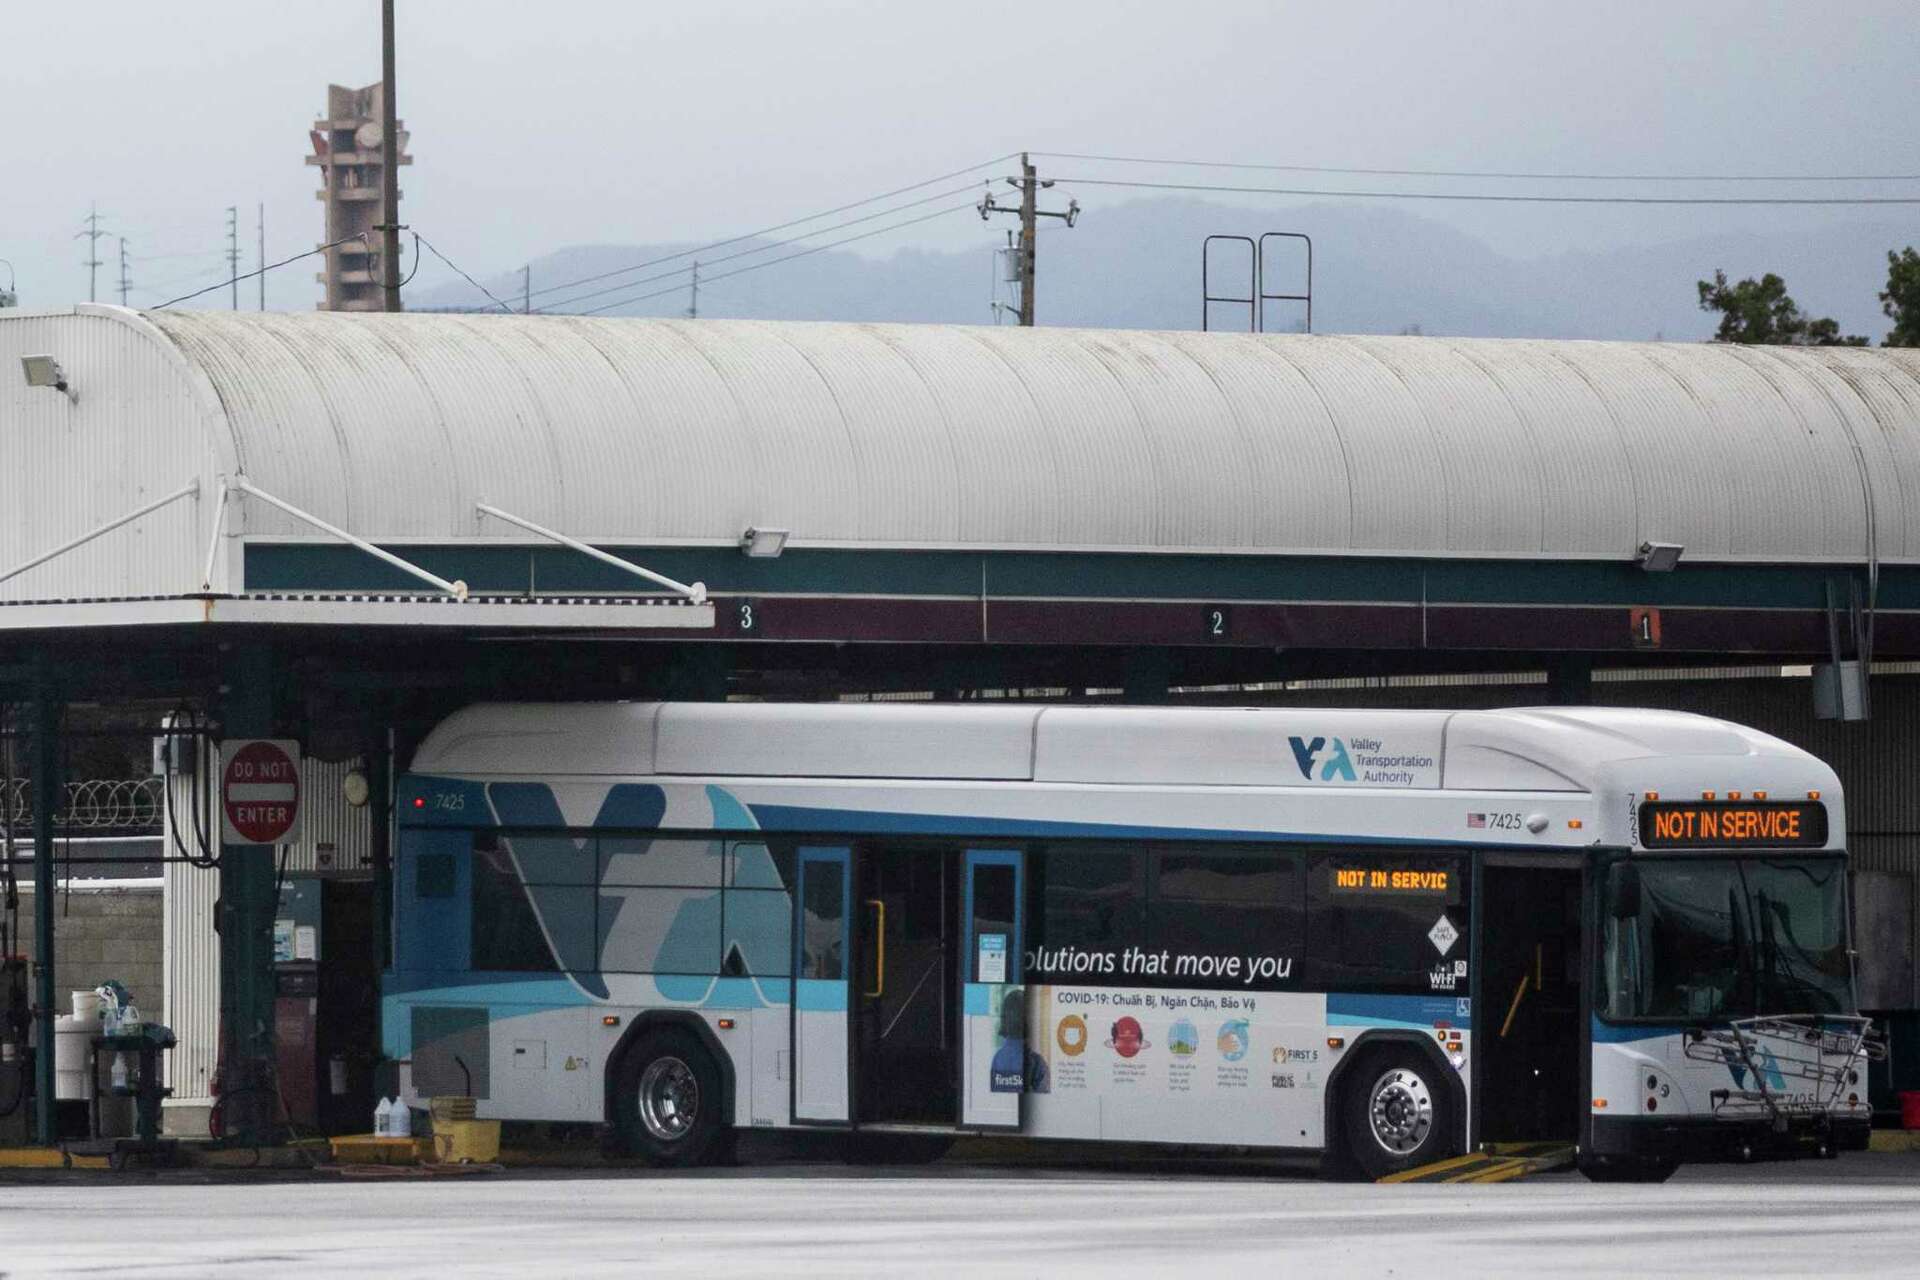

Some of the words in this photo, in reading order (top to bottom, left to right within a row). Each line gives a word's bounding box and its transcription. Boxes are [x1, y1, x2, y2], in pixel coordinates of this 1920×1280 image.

[741, 605, 752, 629] 3
[1212, 611, 1223, 635] 2
[1642, 616, 1649, 640] 1
[1351, 738, 1382, 753] Valley
[1357, 754, 1433, 768] Transportation
[234, 762, 253, 778] DO
[260, 762, 290, 778] NOT
[1363, 771, 1414, 785] Authority
[434, 794, 466, 811] 7425
[237, 807, 288, 824] ENTER
[1489, 813, 1522, 830] 7425
[1655, 811, 1695, 838] NOT
[1700, 811, 1717, 838] IN
[1723, 811, 1800, 838] SERVICE
[1337, 870, 1366, 887] NOT
[1370, 871, 1388, 888] IN
[1391, 871, 1447, 889] SERVIC
[1122, 947, 1168, 975] that
[1174, 954, 1241, 976] move
[1245, 956, 1292, 984] you
[1057, 991, 1110, 1005] COVID-19:
